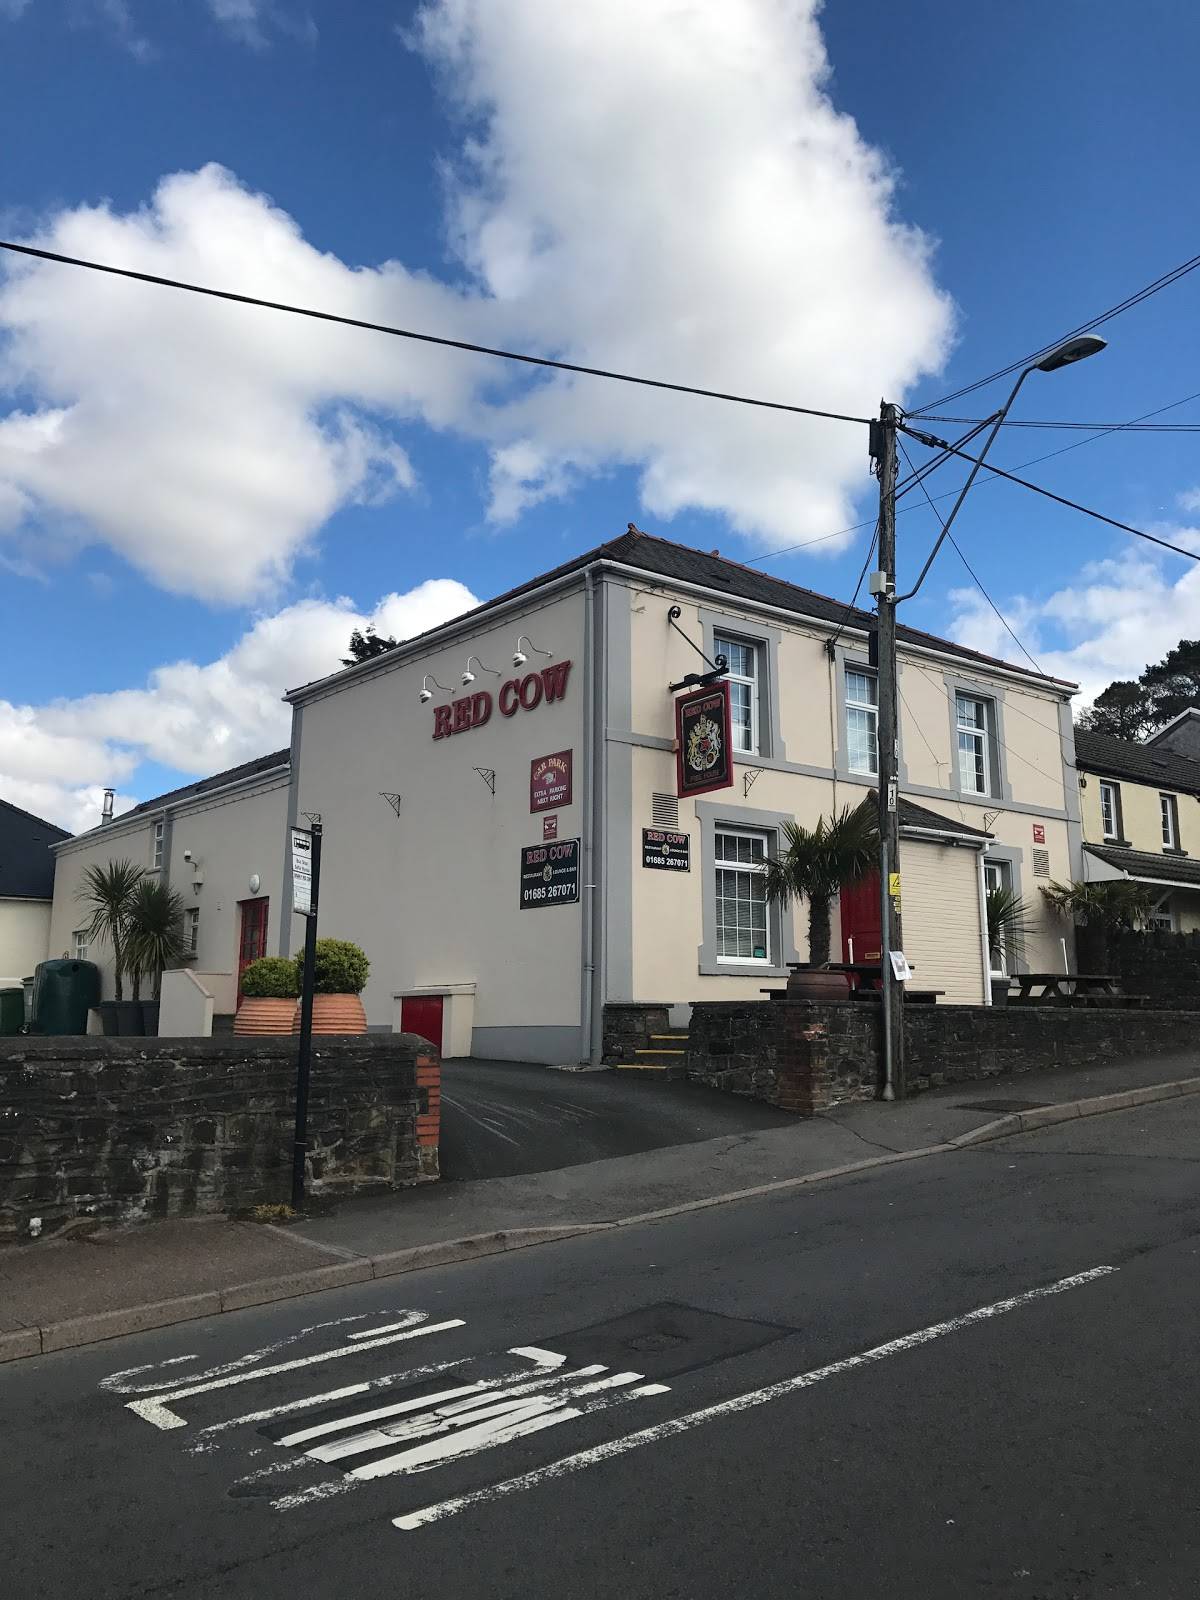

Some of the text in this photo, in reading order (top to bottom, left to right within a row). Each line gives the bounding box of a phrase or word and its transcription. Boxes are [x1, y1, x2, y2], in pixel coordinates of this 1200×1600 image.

[432, 660, 572, 741] RED COW
[534, 758, 567, 781] CAR PARK
[534, 784, 567, 799] EXTRA PARKING
[537, 793, 563, 805] NEXT RIGHT
[647, 831, 686, 845] RED COW
[526, 843, 575, 865] RED COW
[645, 855, 688, 868] 01685 267071
[524, 883, 576, 901] 01685 267071
